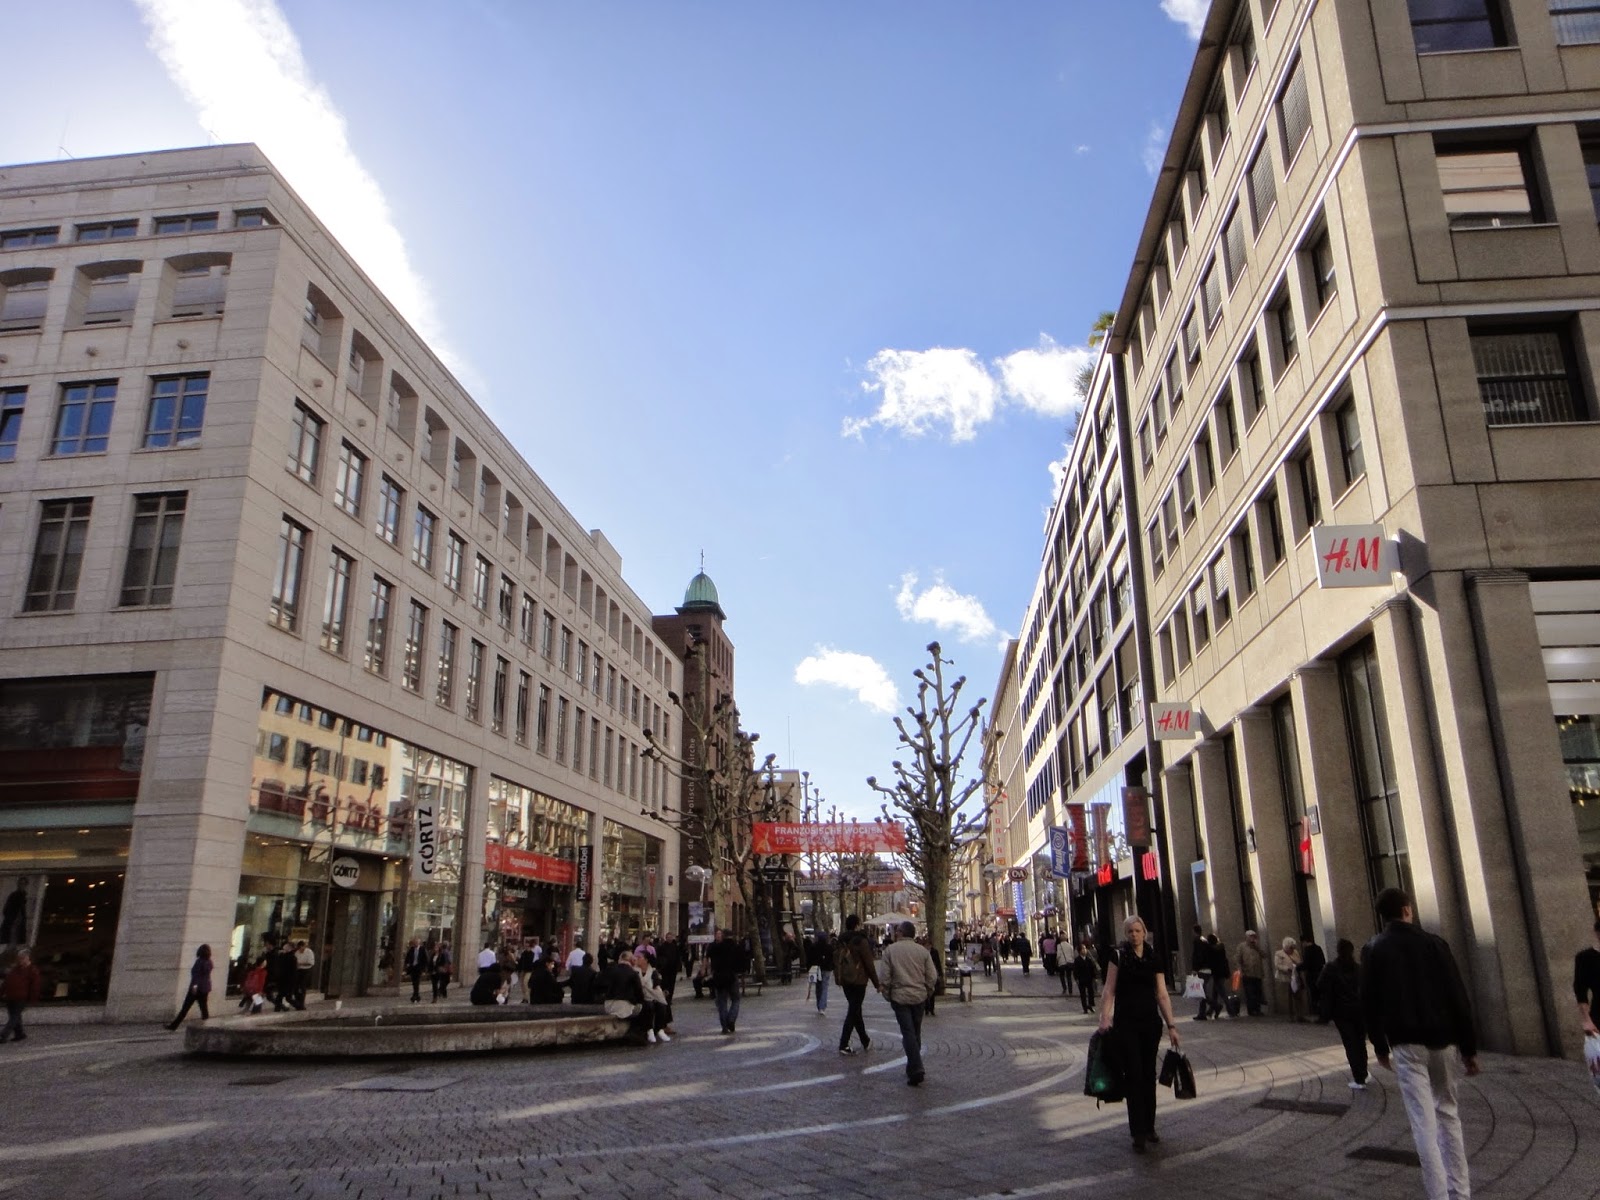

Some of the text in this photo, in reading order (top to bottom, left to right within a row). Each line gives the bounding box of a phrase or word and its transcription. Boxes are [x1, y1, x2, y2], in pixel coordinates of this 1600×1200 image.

[1323, 536, 1380, 574] H&M
[1157, 709, 1190, 732] H&M
[418, 806, 434, 875] GÖRTZ
[578, 847, 590, 900] Hugendubel
